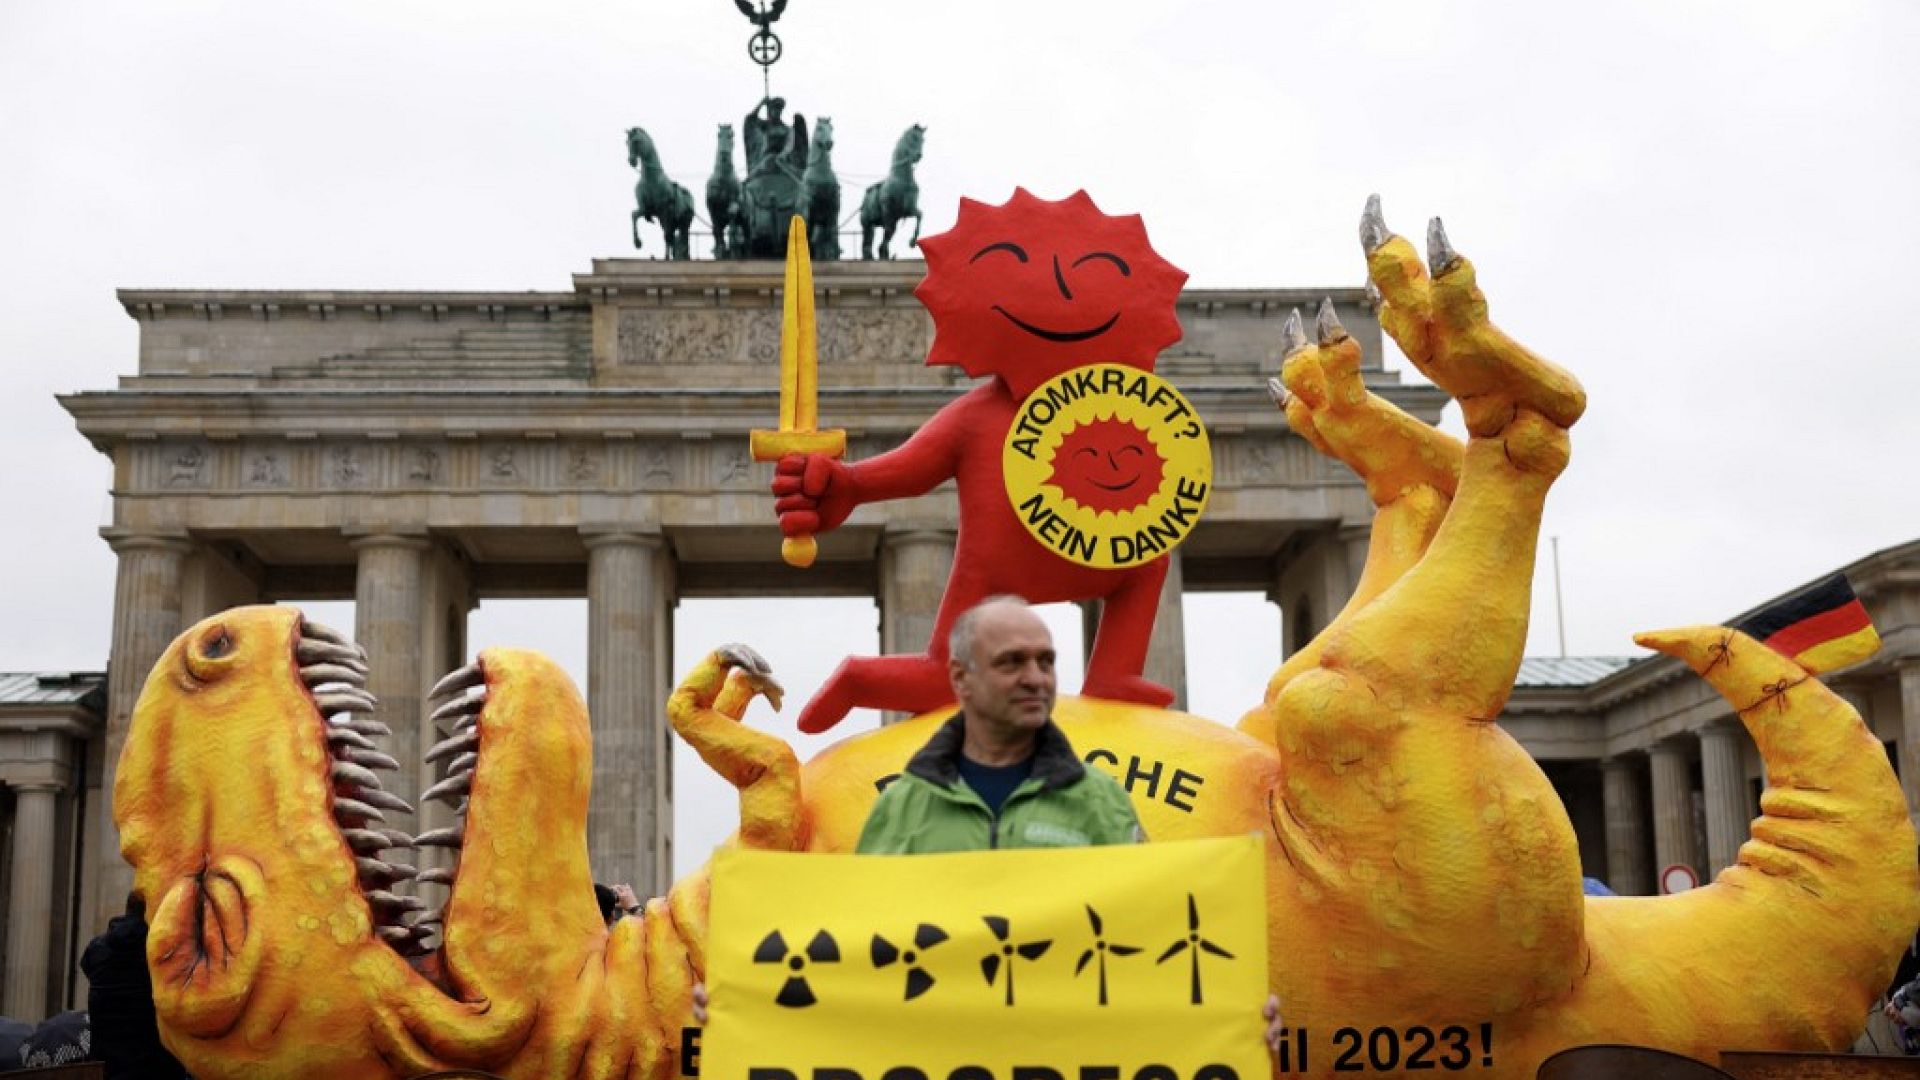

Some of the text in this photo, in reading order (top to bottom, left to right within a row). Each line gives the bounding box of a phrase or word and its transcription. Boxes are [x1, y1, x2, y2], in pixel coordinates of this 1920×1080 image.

[1012, 369, 1201, 460] ATOMKRAFT?
[1019, 476, 1206, 565] NEIN DANKE
[1332, 1021, 1493, 1072] 2023!
